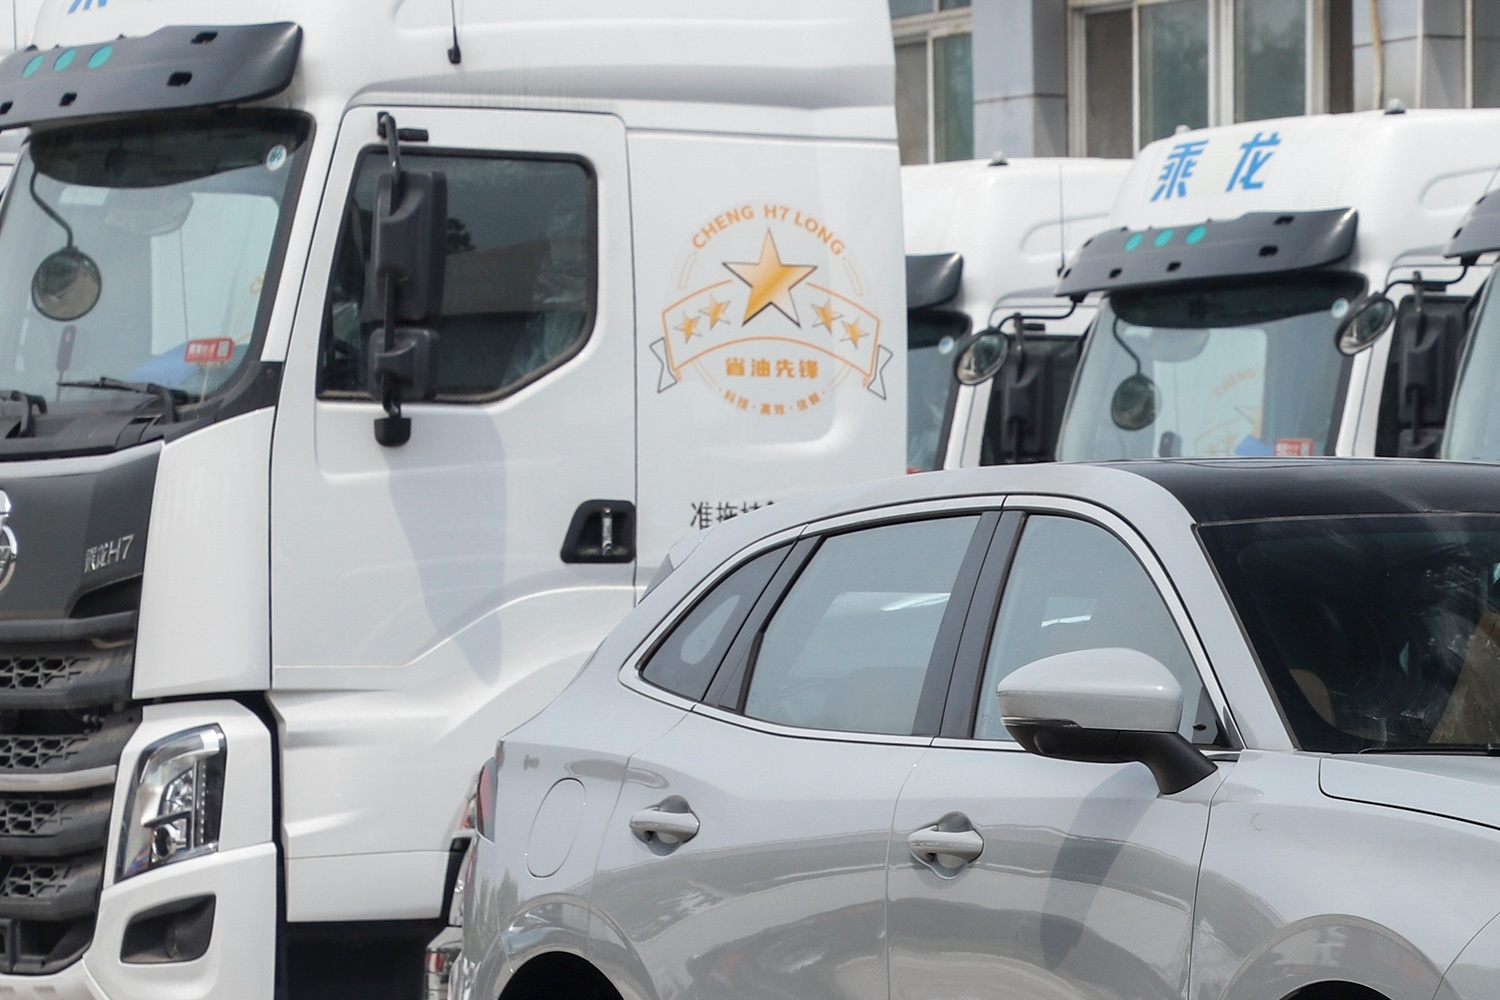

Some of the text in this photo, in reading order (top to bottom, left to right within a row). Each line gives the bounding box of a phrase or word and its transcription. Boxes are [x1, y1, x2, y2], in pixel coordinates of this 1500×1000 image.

[1150, 132, 1281, 203] 乘龙
[692, 204, 846, 256] CHENG H7 LONG
[725, 357, 819, 379] 省油先锋
